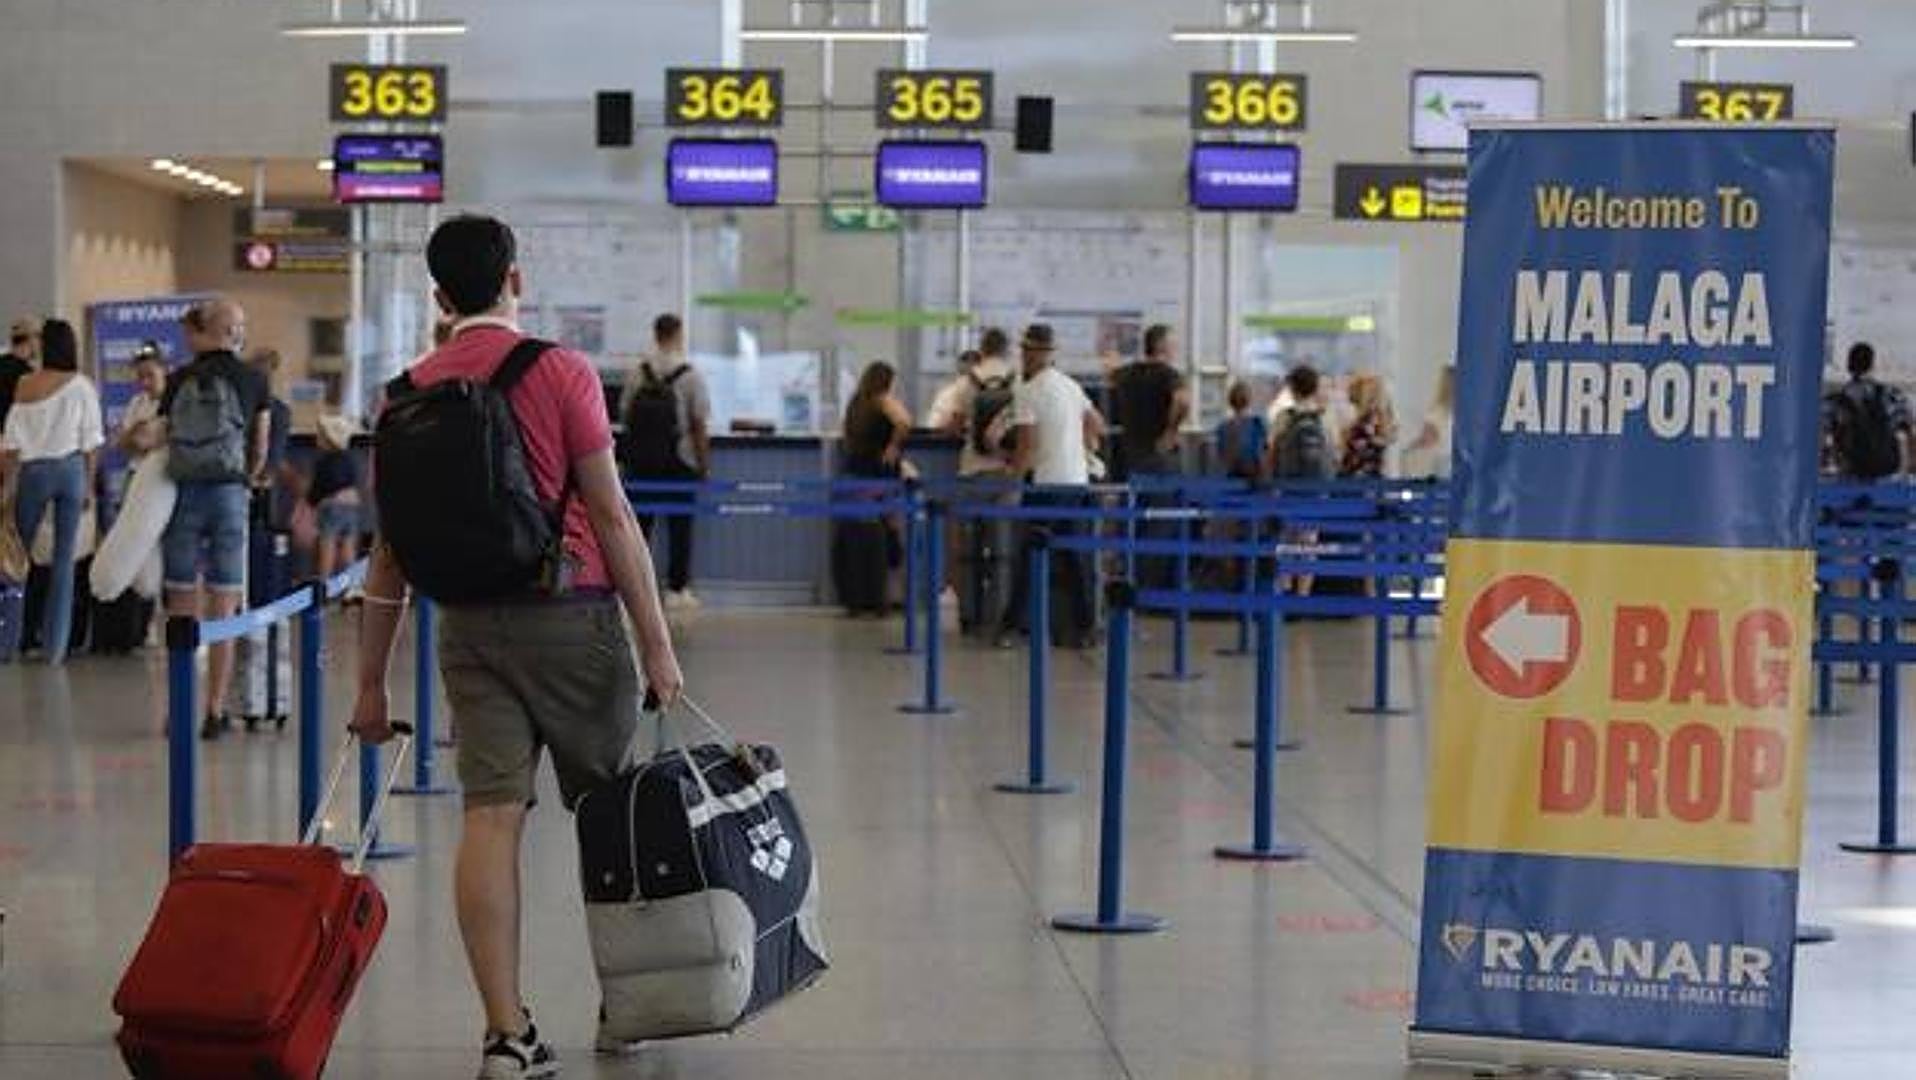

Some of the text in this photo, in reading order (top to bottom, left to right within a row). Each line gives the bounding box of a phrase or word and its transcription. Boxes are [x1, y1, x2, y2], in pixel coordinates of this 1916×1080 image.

[342, 70, 435, 115] 363
[679, 75, 774, 120] 364
[889, 77, 983, 121] 365
[1204, 79, 1298, 124] 366
[1696, 89, 1785, 121] 367
[1536, 186, 1760, 229] Welcome To
[1512, 269, 1773, 348] MALAGA
[1500, 360, 1776, 439] AIRPORT
[1609, 605, 1793, 708] BAG
[1538, 718, 1786, 824] DROP
[1483, 927, 1773, 988] RYANAIR
